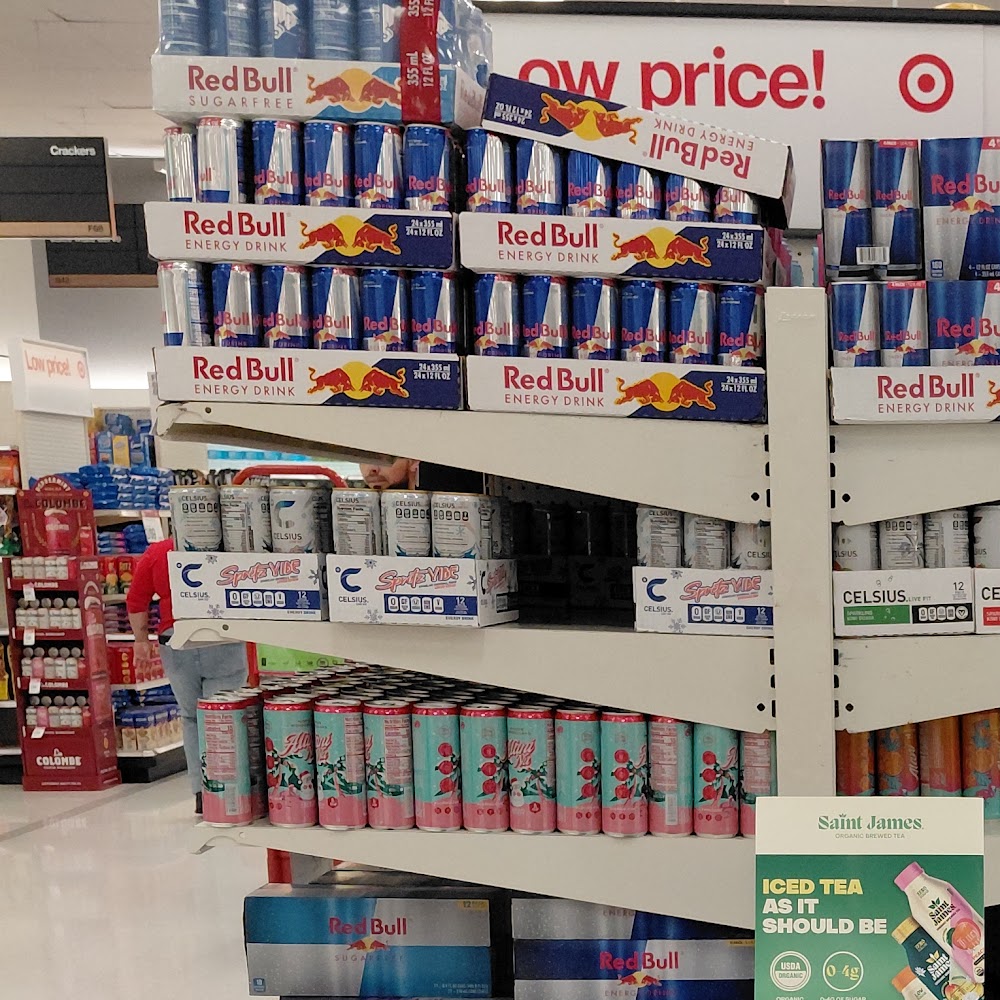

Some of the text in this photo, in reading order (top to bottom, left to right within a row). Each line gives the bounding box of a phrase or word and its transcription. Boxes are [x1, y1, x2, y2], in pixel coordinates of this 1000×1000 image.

[189, 66, 291, 93] Red Bull
[407, 65, 418, 86] 355
[424, 76, 434, 87] 12
[518, 46, 826, 110] ow price!
[189, 96, 293, 109] SUGARFREE
[654, 118, 754, 151] ENERGY DRINK
[50, 145, 96, 156] Crackers
[650, 134, 751, 179] Red Bull
[931, 173, 970, 195] Red
[184, 210, 285, 237] Red Bull
[498, 221, 598, 247] Red Bull
[185, 239, 287, 252] ENERGY DRINK
[24, 350, 71, 377] Low price!
[193, 356, 293, 381] Red Bull
[504, 366, 603, 392] Red Bull
[878, 373, 974, 399] Red Bull
[194, 384, 295, 396] ENERGY DRINK
[878, 402, 974, 414] ENERGY DRINK
[953, 581, 964, 591] 12
[818, 814, 862, 830] Saint
[763, 879, 863, 895] ICED TEA
[763, 899, 819, 914] AS IT
[329, 917, 406, 936] Red Bull
[762, 918, 887, 934] SHOULD BE
[600, 951, 679, 970] Red Bull
[781, 962, 800, 970] USDA
